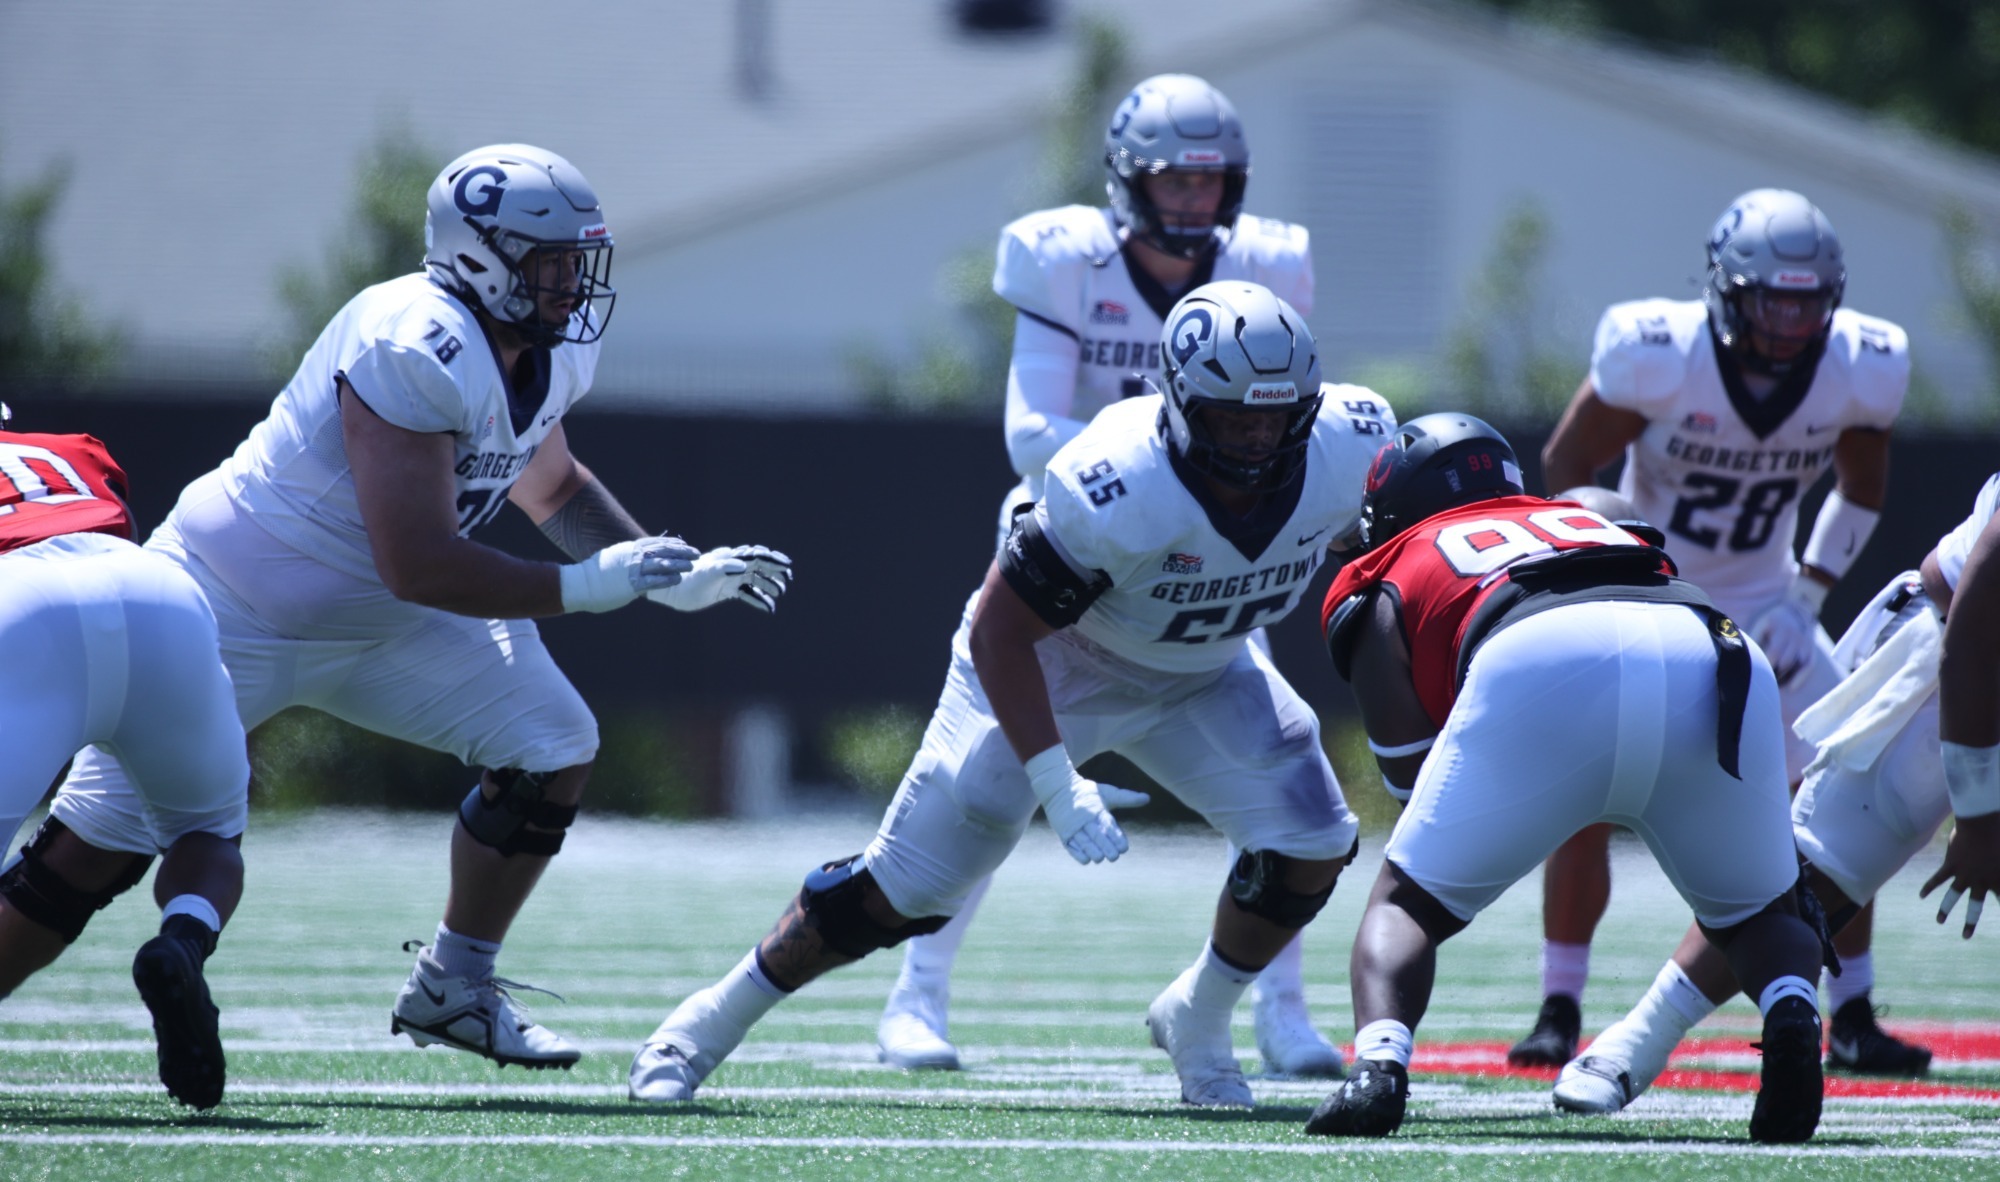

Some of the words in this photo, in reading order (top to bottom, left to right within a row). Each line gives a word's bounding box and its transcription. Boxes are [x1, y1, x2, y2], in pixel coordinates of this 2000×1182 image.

[454, 165, 508, 218] G
[422, 318, 463, 365] 78
[1171, 308, 1212, 369] G
[1252, 388, 1295, 400] Riddell
[1342, 399, 1385, 437] 55
[1076, 457, 1128, 508] 55
[1467, 453, 1493, 472] 99
[1668, 472, 1799, 553] 28
[1149, 547, 1319, 604] GEORGETOWN
